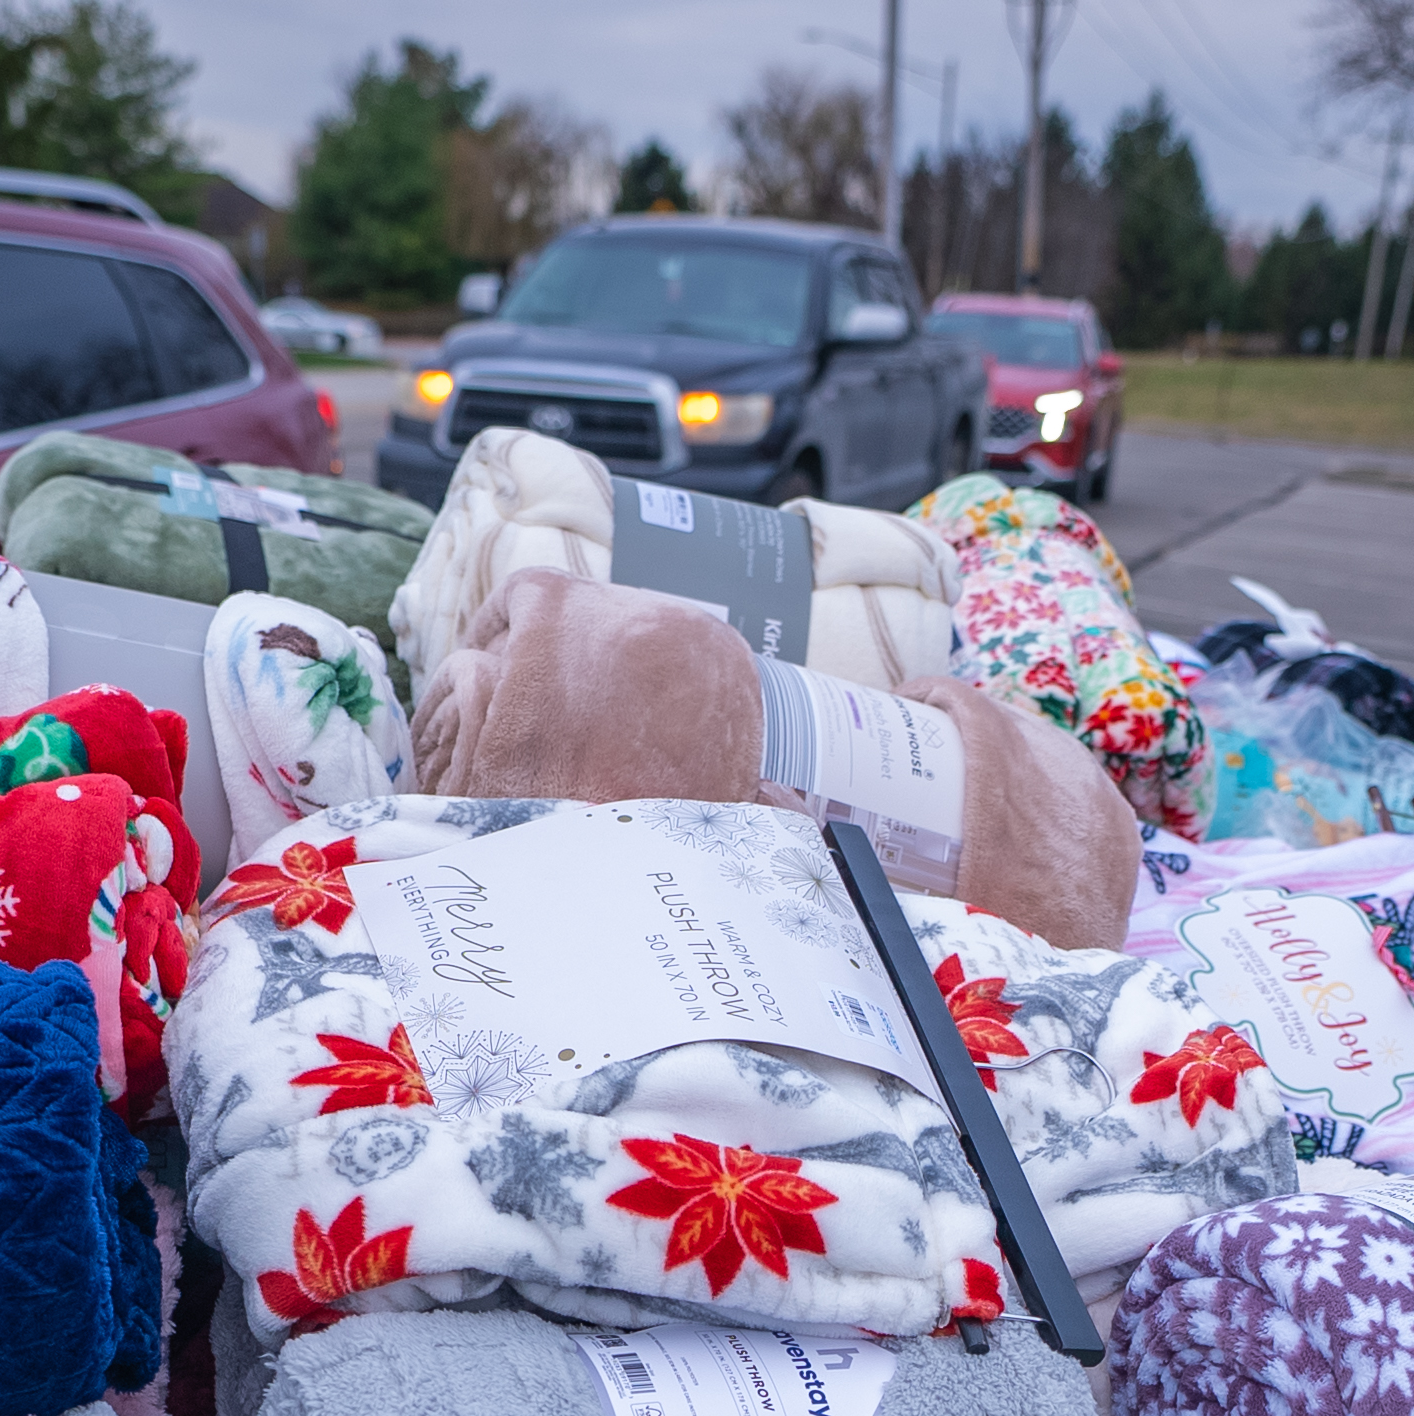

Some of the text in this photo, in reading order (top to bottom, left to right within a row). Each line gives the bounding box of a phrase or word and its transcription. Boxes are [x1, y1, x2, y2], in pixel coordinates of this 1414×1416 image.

[877, 728, 894, 779] Blanket
[907, 732, 921, 778] HOUSE
[395, 874, 450, 962] EVERYTHING
[424, 866, 514, 997] Merry
[646, 870, 753, 1020] PLUSH THROW
[644, 934, 710, 1019] 50 IN X 70 IN
[716, 922, 787, 1026] WARM & COZY
[1227, 928, 1316, 1055] OVERSIZED PLUSH THROW
[684, 1392, 692, 1403] CARE
[725, 1335, 775, 1410] PLUSH THROW
[729, 1376, 737, 1384] CM
